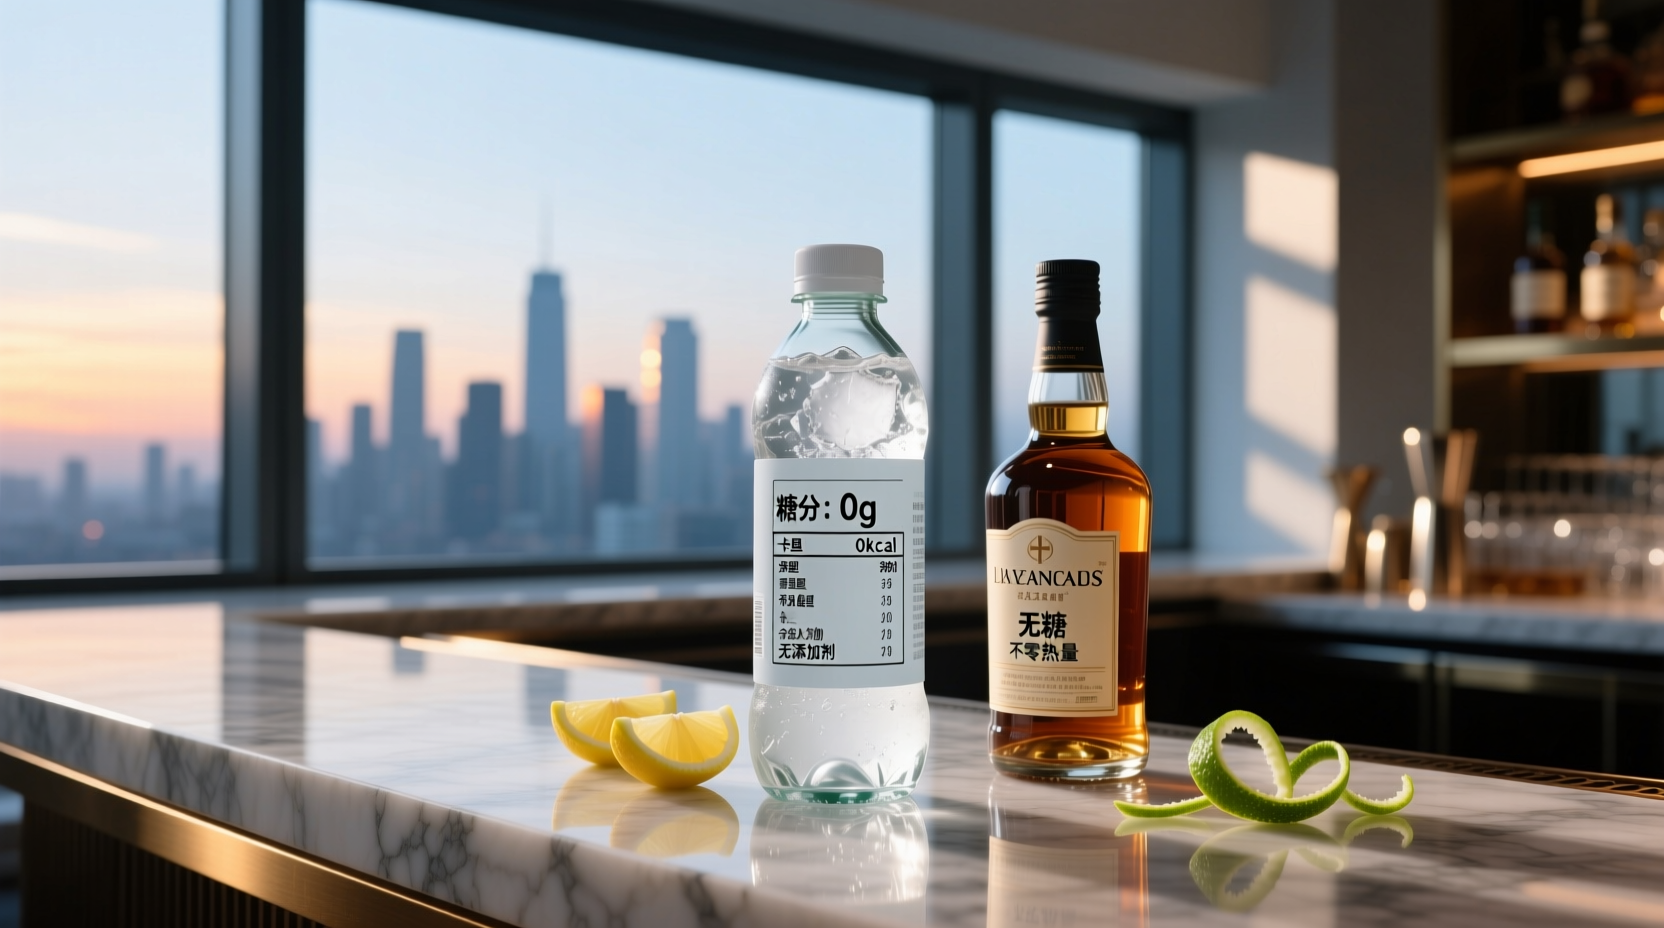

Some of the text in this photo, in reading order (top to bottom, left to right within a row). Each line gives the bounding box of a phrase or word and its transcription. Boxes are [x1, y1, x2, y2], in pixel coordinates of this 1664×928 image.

[840, 492, 877, 528] 0g
[855, 537, 897, 553] 0kcal
[1018, 611, 1068, 639] 无糖
[778, 643, 836, 661] 无添加剂
